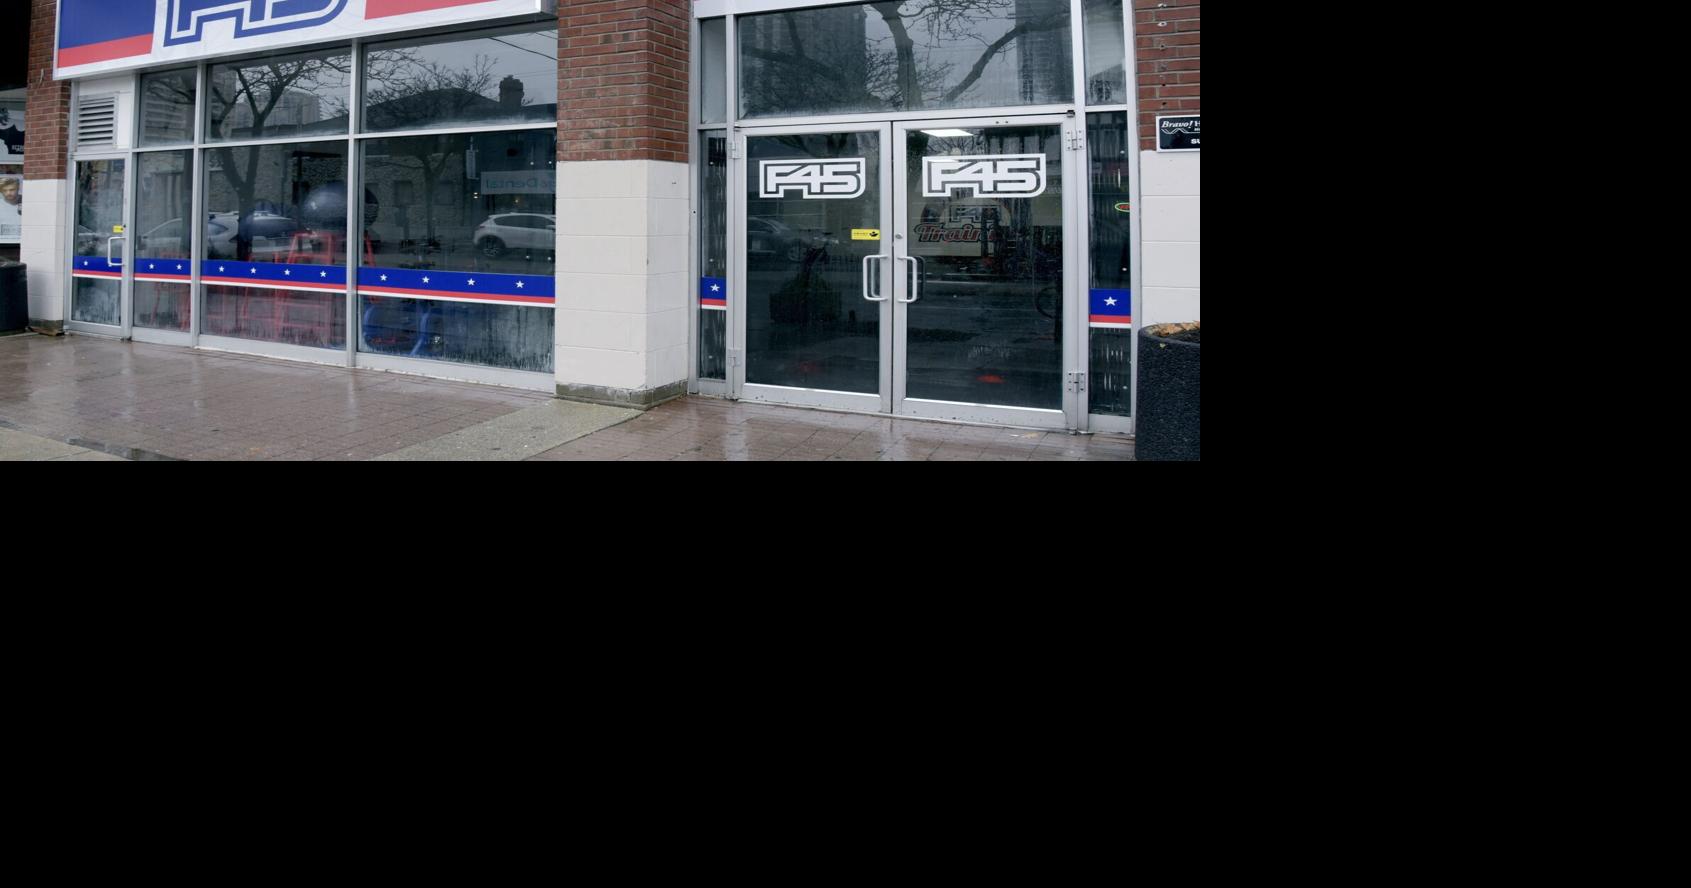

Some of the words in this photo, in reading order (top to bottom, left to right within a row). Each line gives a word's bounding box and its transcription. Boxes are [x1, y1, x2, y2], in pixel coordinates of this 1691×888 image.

[1161, 120, 1194, 129] Bravo!
[759, 157, 866, 199] F45
[922, 153, 1046, 198] F45
[950, 204, 1001, 223] F4
